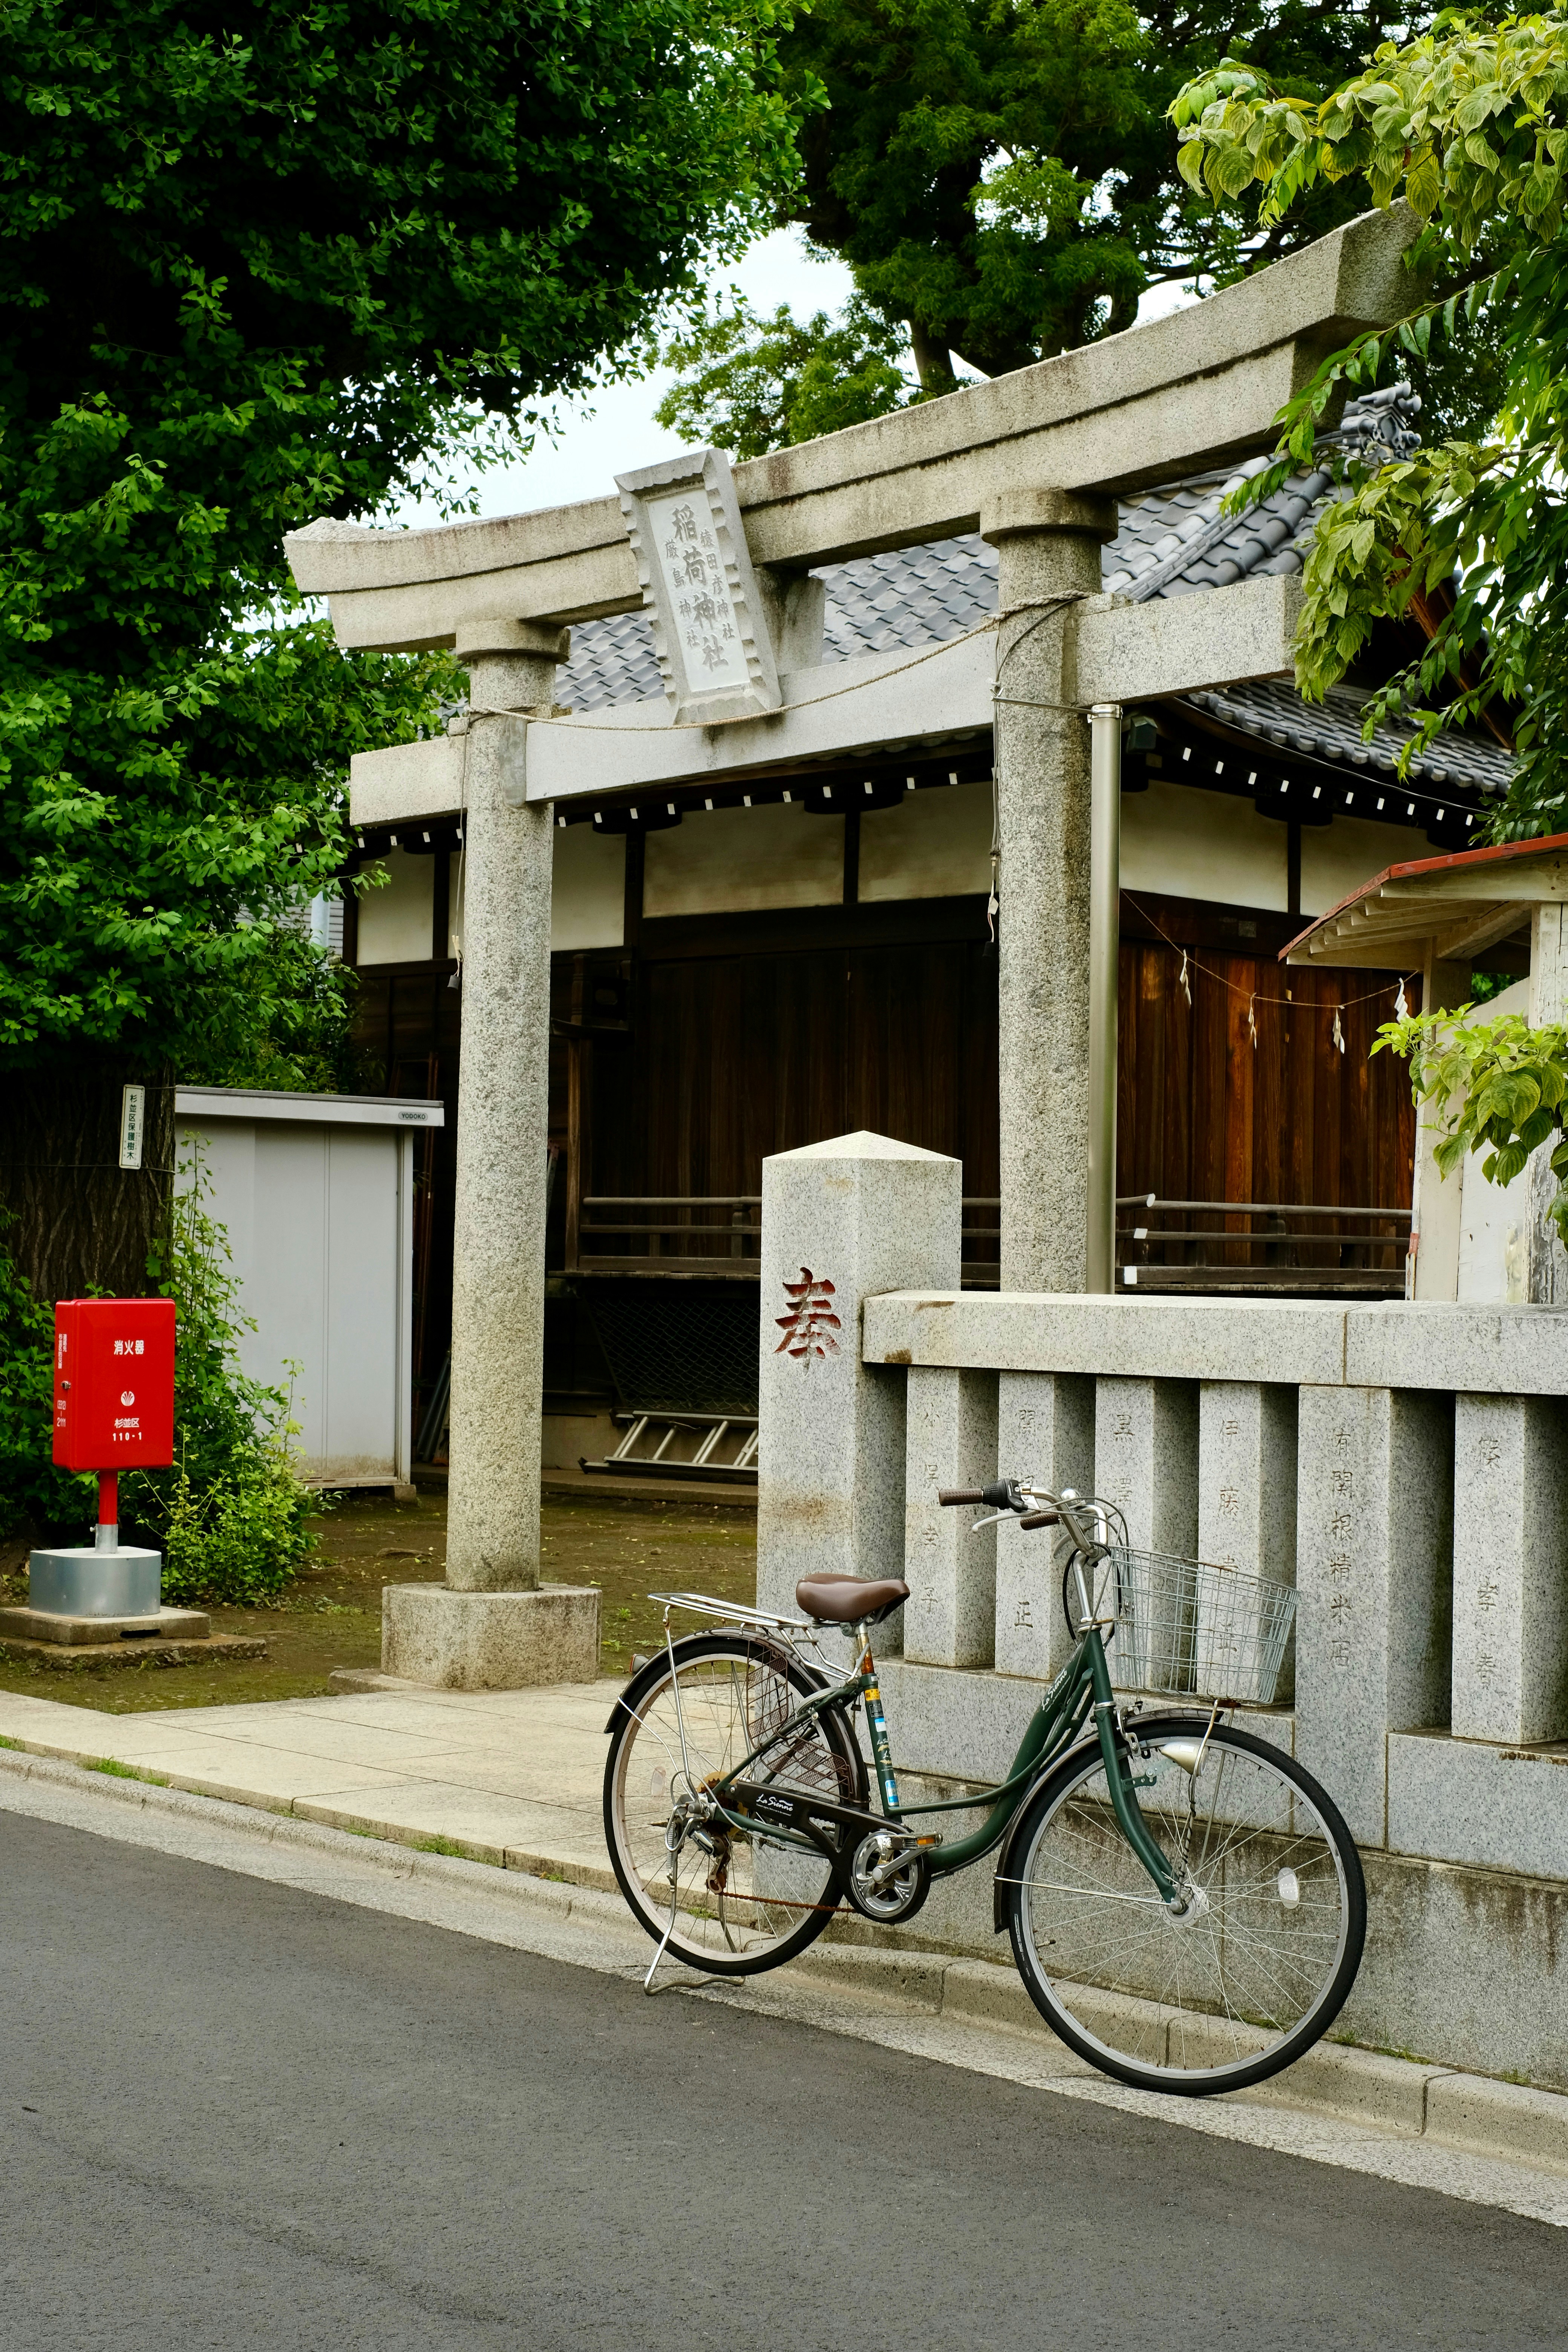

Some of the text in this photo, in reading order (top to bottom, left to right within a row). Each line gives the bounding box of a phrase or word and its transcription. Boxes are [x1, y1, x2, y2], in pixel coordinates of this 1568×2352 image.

[665, 539, 700, 648] 厳島神社
[672, 504, 729, 672] 稲荷神社
[700, 528, 735, 641] 猿田彦神社
[126, 1094, 137, 1160] 杉並区保護樹木
[113, 1340, 144, 1355] 消火器
[773, 1267, 842, 1377] 奉
[112, 1432, 142, 1442] 110-1
[114, 1418, 140, 1429] 杉並区
[756, 1793, 767, 1804] La
[768, 1796, 793, 1811] Sienne
